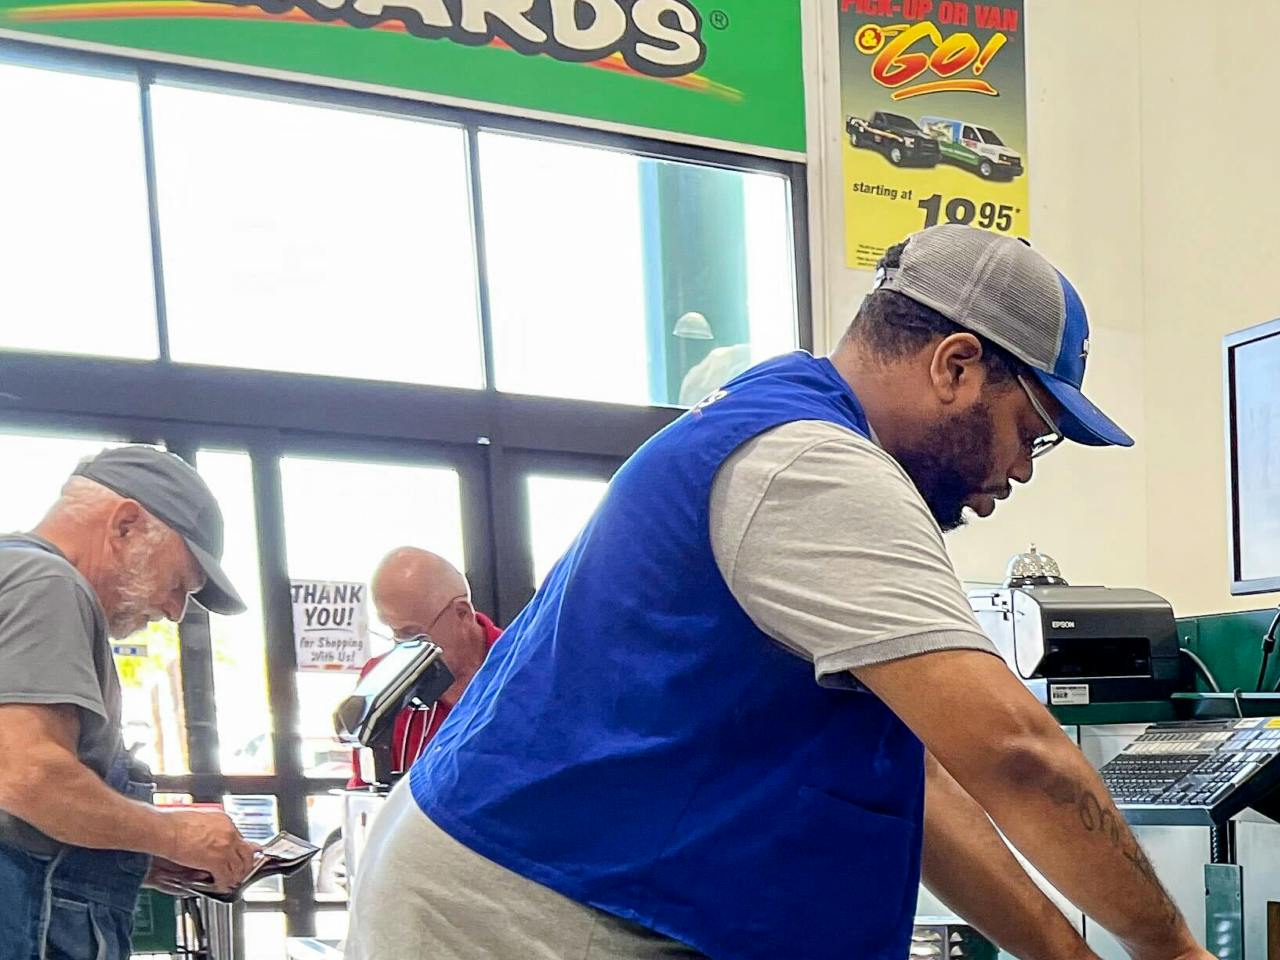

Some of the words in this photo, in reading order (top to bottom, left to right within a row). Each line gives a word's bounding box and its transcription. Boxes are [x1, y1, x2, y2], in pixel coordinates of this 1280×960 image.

[938, 2, 968, 27] OR
[974, 6, 1018, 32] VAN
[871, 21, 1008, 88] GO!
[852, 181, 898, 200] starting
[900, 189, 913, 201] at
[291, 584, 363, 605] THANK
[305, 606, 355, 627] YOU!
[1051, 621, 1075, 629] EPSON
